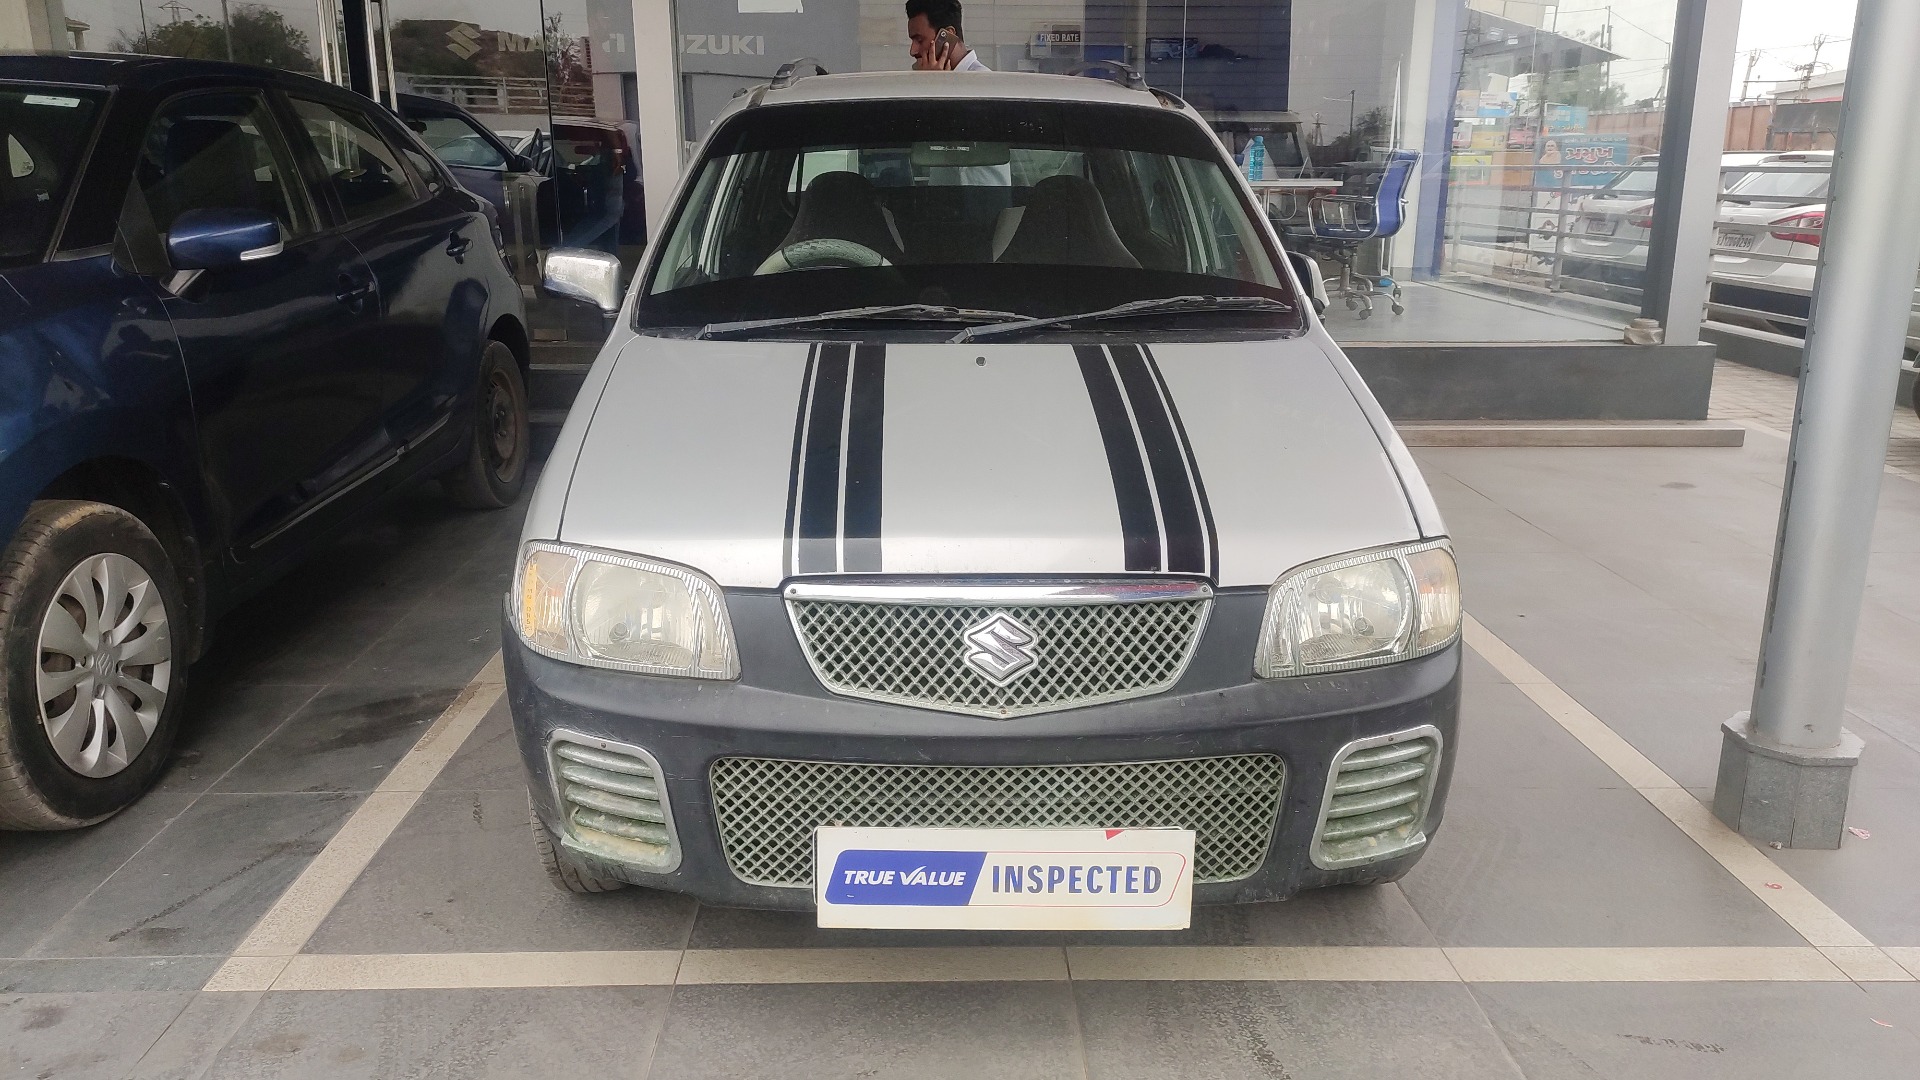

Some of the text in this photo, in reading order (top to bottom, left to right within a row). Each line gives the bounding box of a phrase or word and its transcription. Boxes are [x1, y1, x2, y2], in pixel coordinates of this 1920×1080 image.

[680, 34, 765, 55] ZUKI
[1040, 33, 1080, 42] FIXED RATE
[843, 864, 1163, 895] TRUE VALUE INSPECTED
